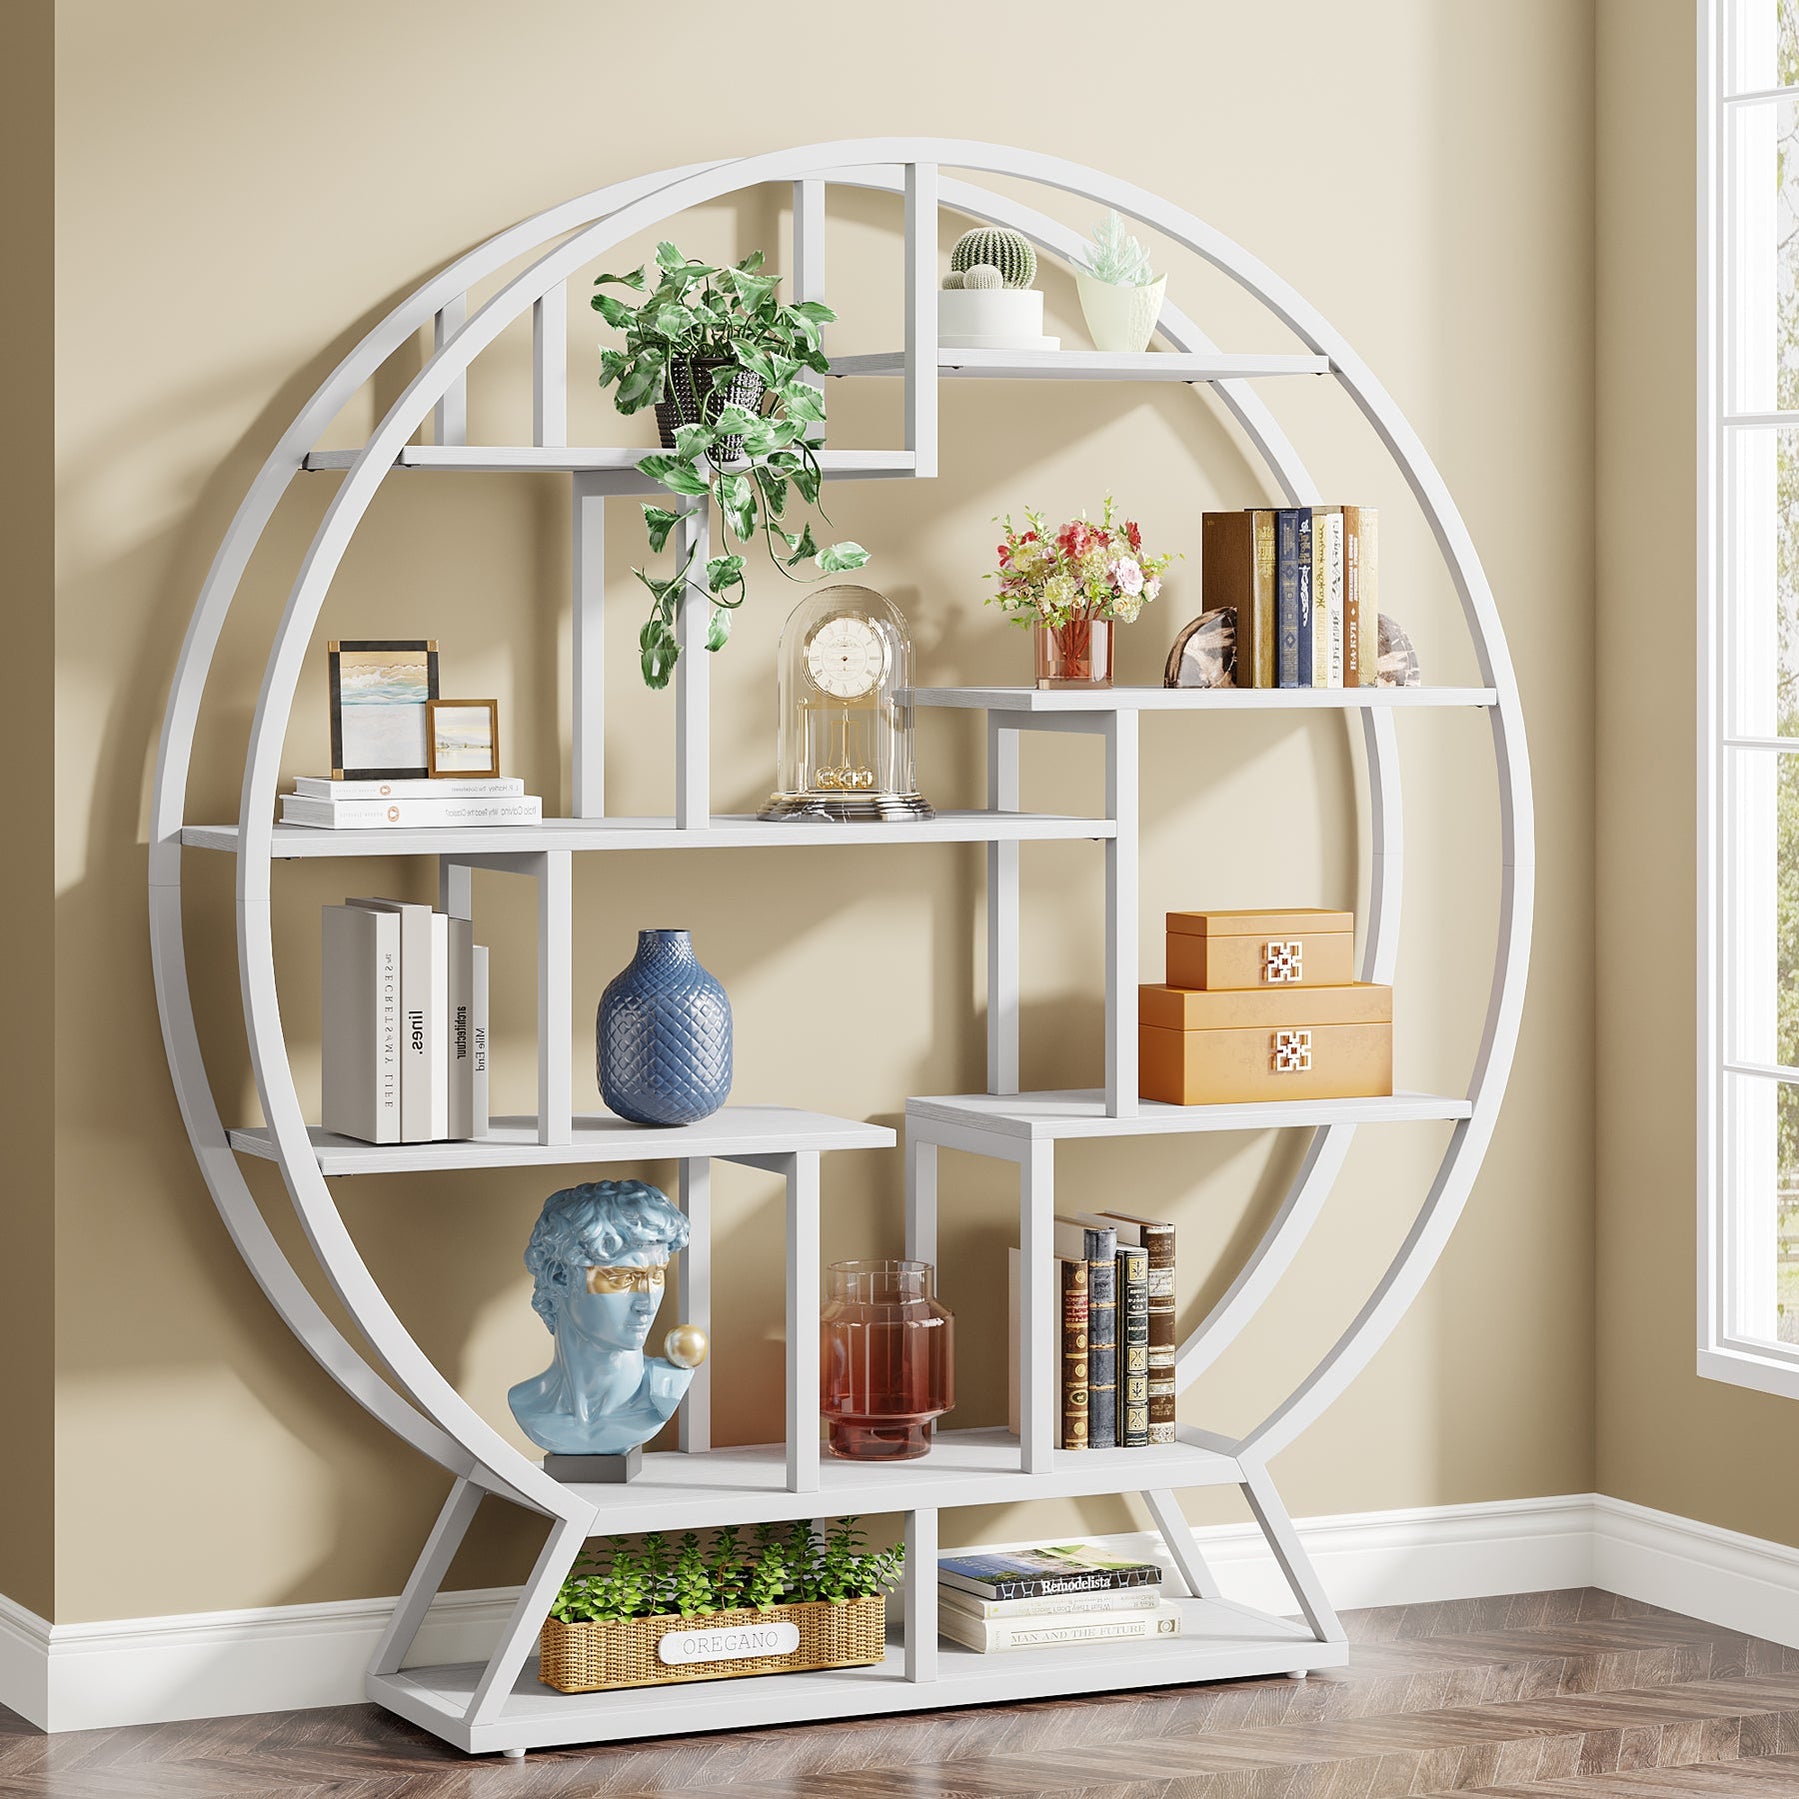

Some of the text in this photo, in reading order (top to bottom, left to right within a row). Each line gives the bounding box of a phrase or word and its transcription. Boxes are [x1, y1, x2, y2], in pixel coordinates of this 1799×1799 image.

[1041, 1576, 1111, 1593] Remodelista
[683, 1631, 779, 1655] OREGANO
[1010, 1632, 1039, 1644] MAN
[1039, 1630, 1068, 1642] AND
[1071, 1627, 1097, 1638] THE
[1099, 1624, 1146, 1637] FUTURE
